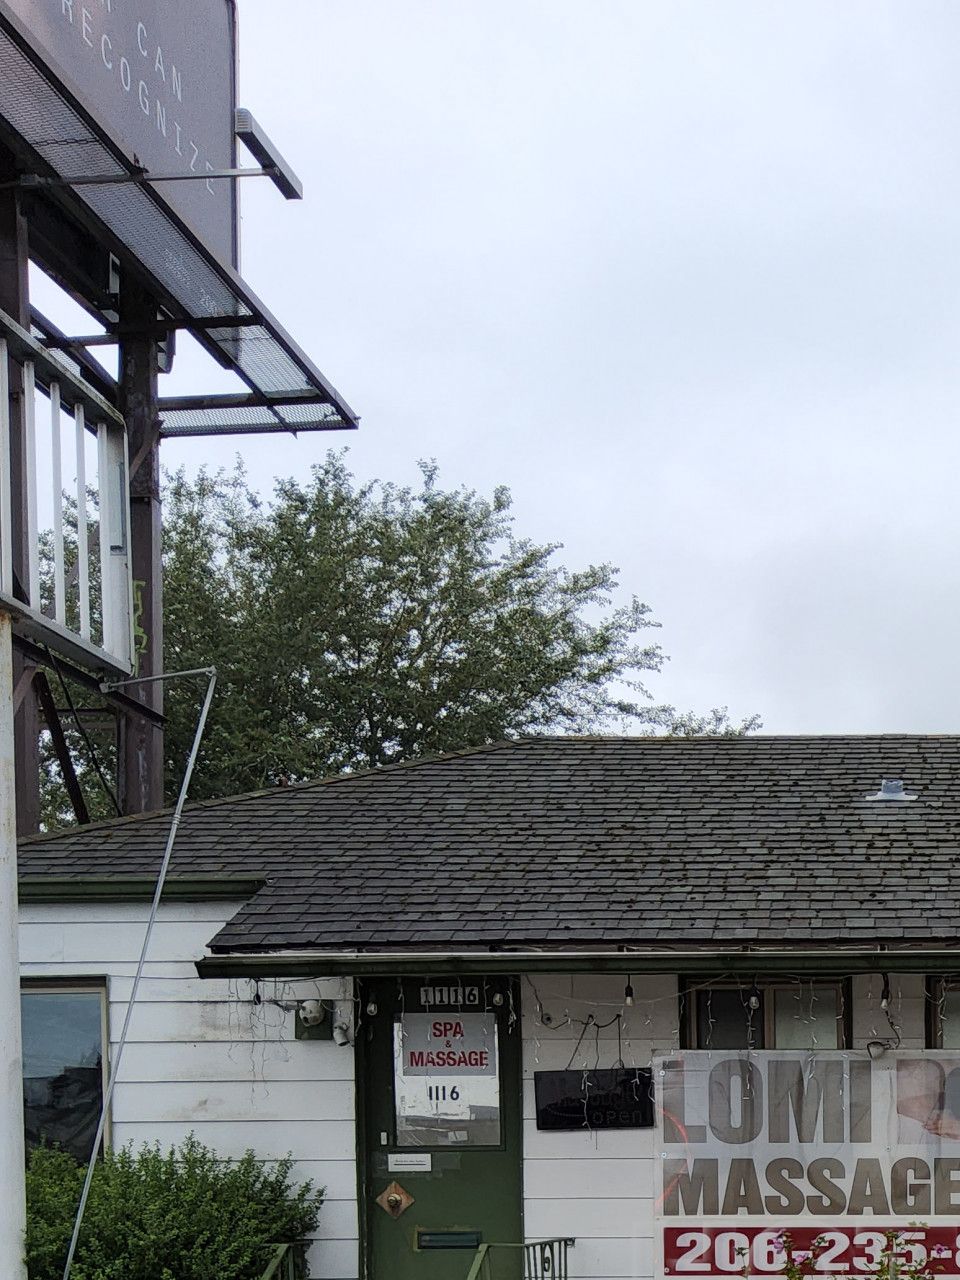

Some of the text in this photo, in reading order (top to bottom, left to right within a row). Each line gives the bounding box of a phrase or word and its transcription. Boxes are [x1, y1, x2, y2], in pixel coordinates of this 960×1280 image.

[137, 21, 182, 102] CAN
[422, 987, 477, 1004] 1116
[432, 1021, 464, 1038] SPA
[445, 1040, 452, 1048] &
[409, 1050, 489, 1067] MASSAGE
[429, 1085, 460, 1101] 1116
[663, 1058, 872, 1145] LOMI
